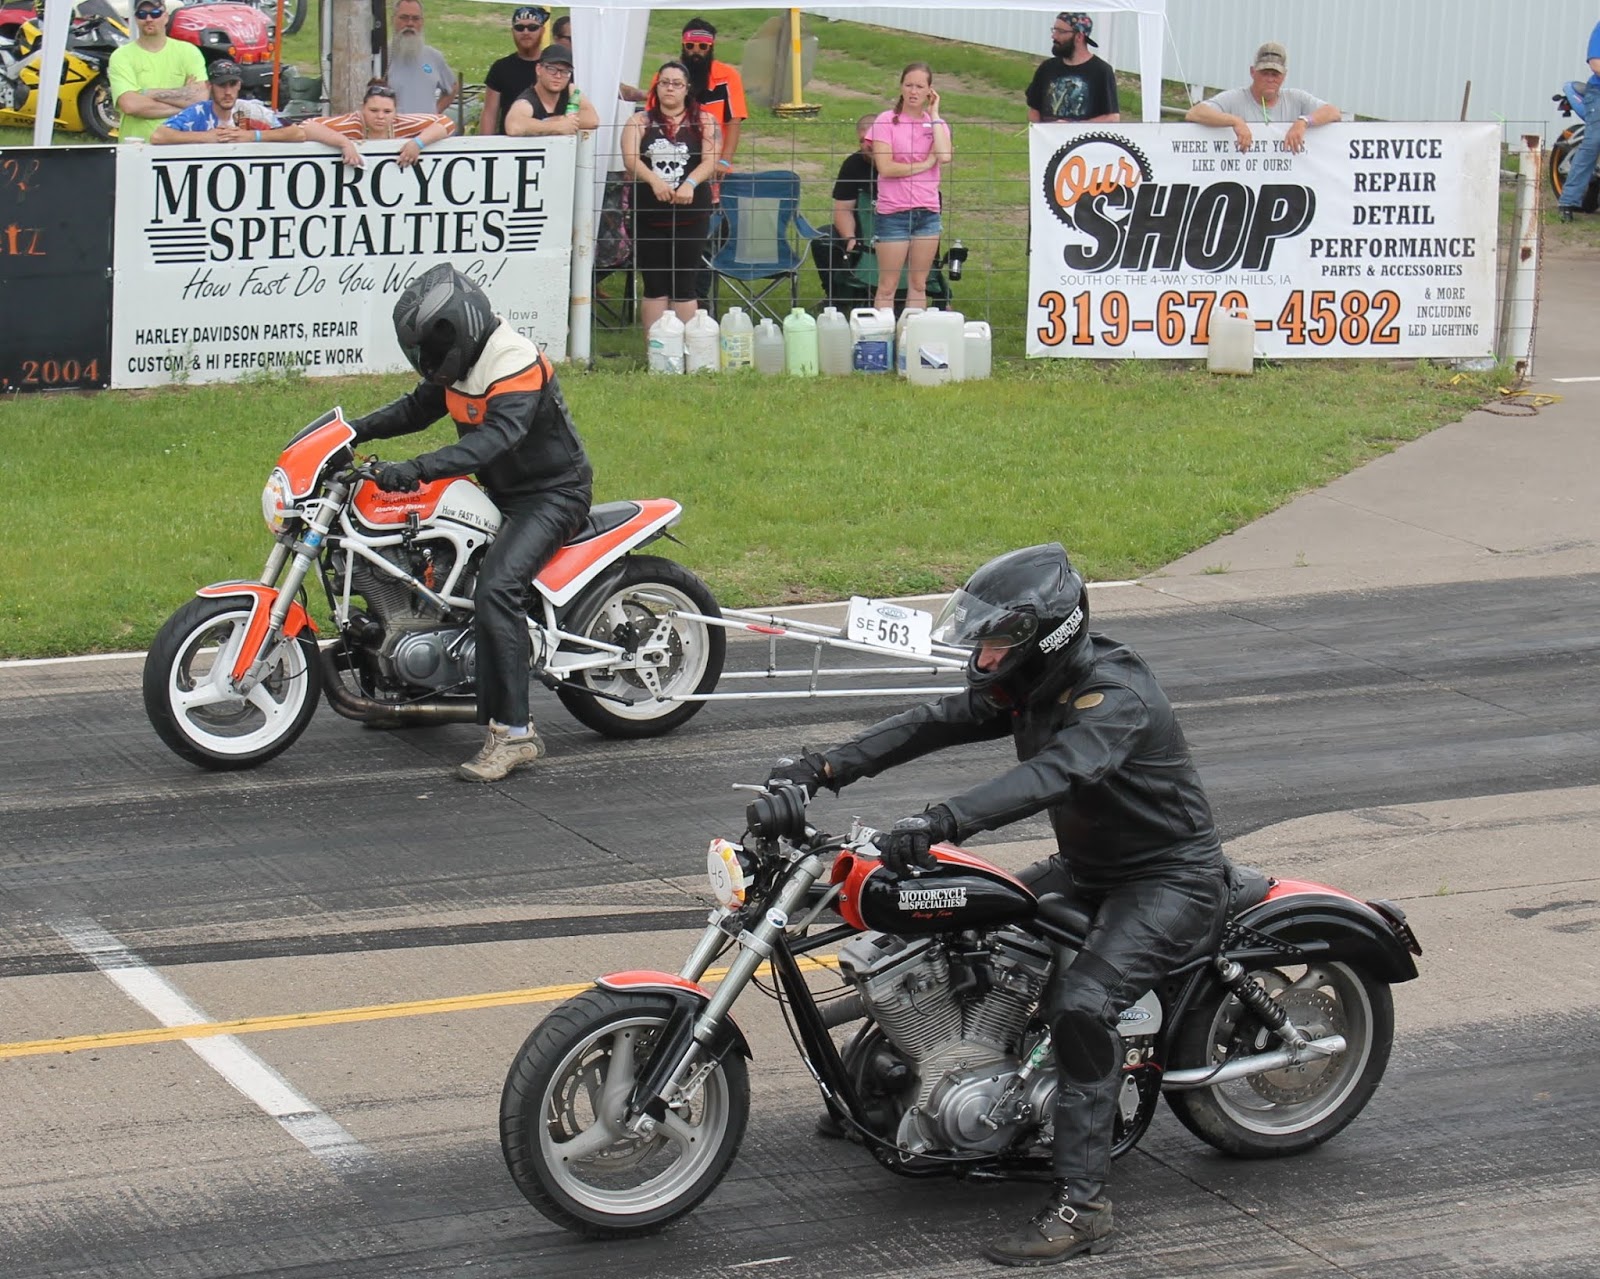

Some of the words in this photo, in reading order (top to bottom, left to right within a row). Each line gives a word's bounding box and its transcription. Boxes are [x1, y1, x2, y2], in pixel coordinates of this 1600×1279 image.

[1171, 140, 1208, 153] WHERE
[1213, 140, 1229, 153] WE
[1349, 139, 1442, 160] SERVICE
[1192, 159, 1216, 172] LIKE
[1220, 159, 1241, 172] ONE
[1245, 159, 1258, 172] OF
[1263, 158, 1293, 172] OURS!
[150, 155, 546, 224] MOTORCYCLE
[1054, 155, 1143, 208] Our
[1353, 172, 1437, 193] REPAIR
[1352, 205, 1436, 226] DETAIL
[209, 209, 506, 263] SPECIALTIES
[1063, 181, 1317, 274] SHOP
[1309, 237, 1476, 258] PERFORMANCE
[1060, 274, 1101, 286] SOUTH
[1105, 274, 1121, 286] OF
[1124, 274, 1147, 286] THE
[1150, 274, 1188, 286] 4-WAY
[1191, 274, 1222, 286] STOP
[1225, 274, 1237, 286] IN
[1241, 274, 1277, 287] HILLS,
[1280, 274, 1292, 286] IA
[1321, 264, 1361, 277] PARTS
[1366, 264, 1376, 276] &
[1381, 264, 1463, 276] ACCESSORIES
[182, 267, 231, 301] How
[239, 265, 289, 298] Fast
[294, 264, 326, 297] Do
[338, 262, 376, 296] You
[1424, 287, 1432, 300] &
[1436, 287, 1466, 300] MORE
[508, 308, 539, 321] Iowa
[1417, 305, 1472, 319] INCLUDING
[135, 328, 189, 346] HARLEY
[193, 325, 259, 343] DAVIDSON
[263, 323, 308, 342] PARTS,
[312, 321, 359, 338] REPAIR
[1408, 324, 1428, 337] LED
[1431, 323, 1479, 337] LIGHTING
[192, 354, 201, 370] &
[206, 354, 220, 370] HI
[224, 350, 322, 369] PERFORMANCE
[325, 348, 364, 365] WORK
[22, 358, 99, 383] 2004
[457, 509, 475, 521] FAST
[856, 617, 875, 632] SE
[877, 619, 910, 647] 563
[1038, 605, 1084, 651] MOTORCYCLE
[899, 887, 967, 903] MOTORCYCLE
[909, 900, 961, 911] SPECIALTIES
